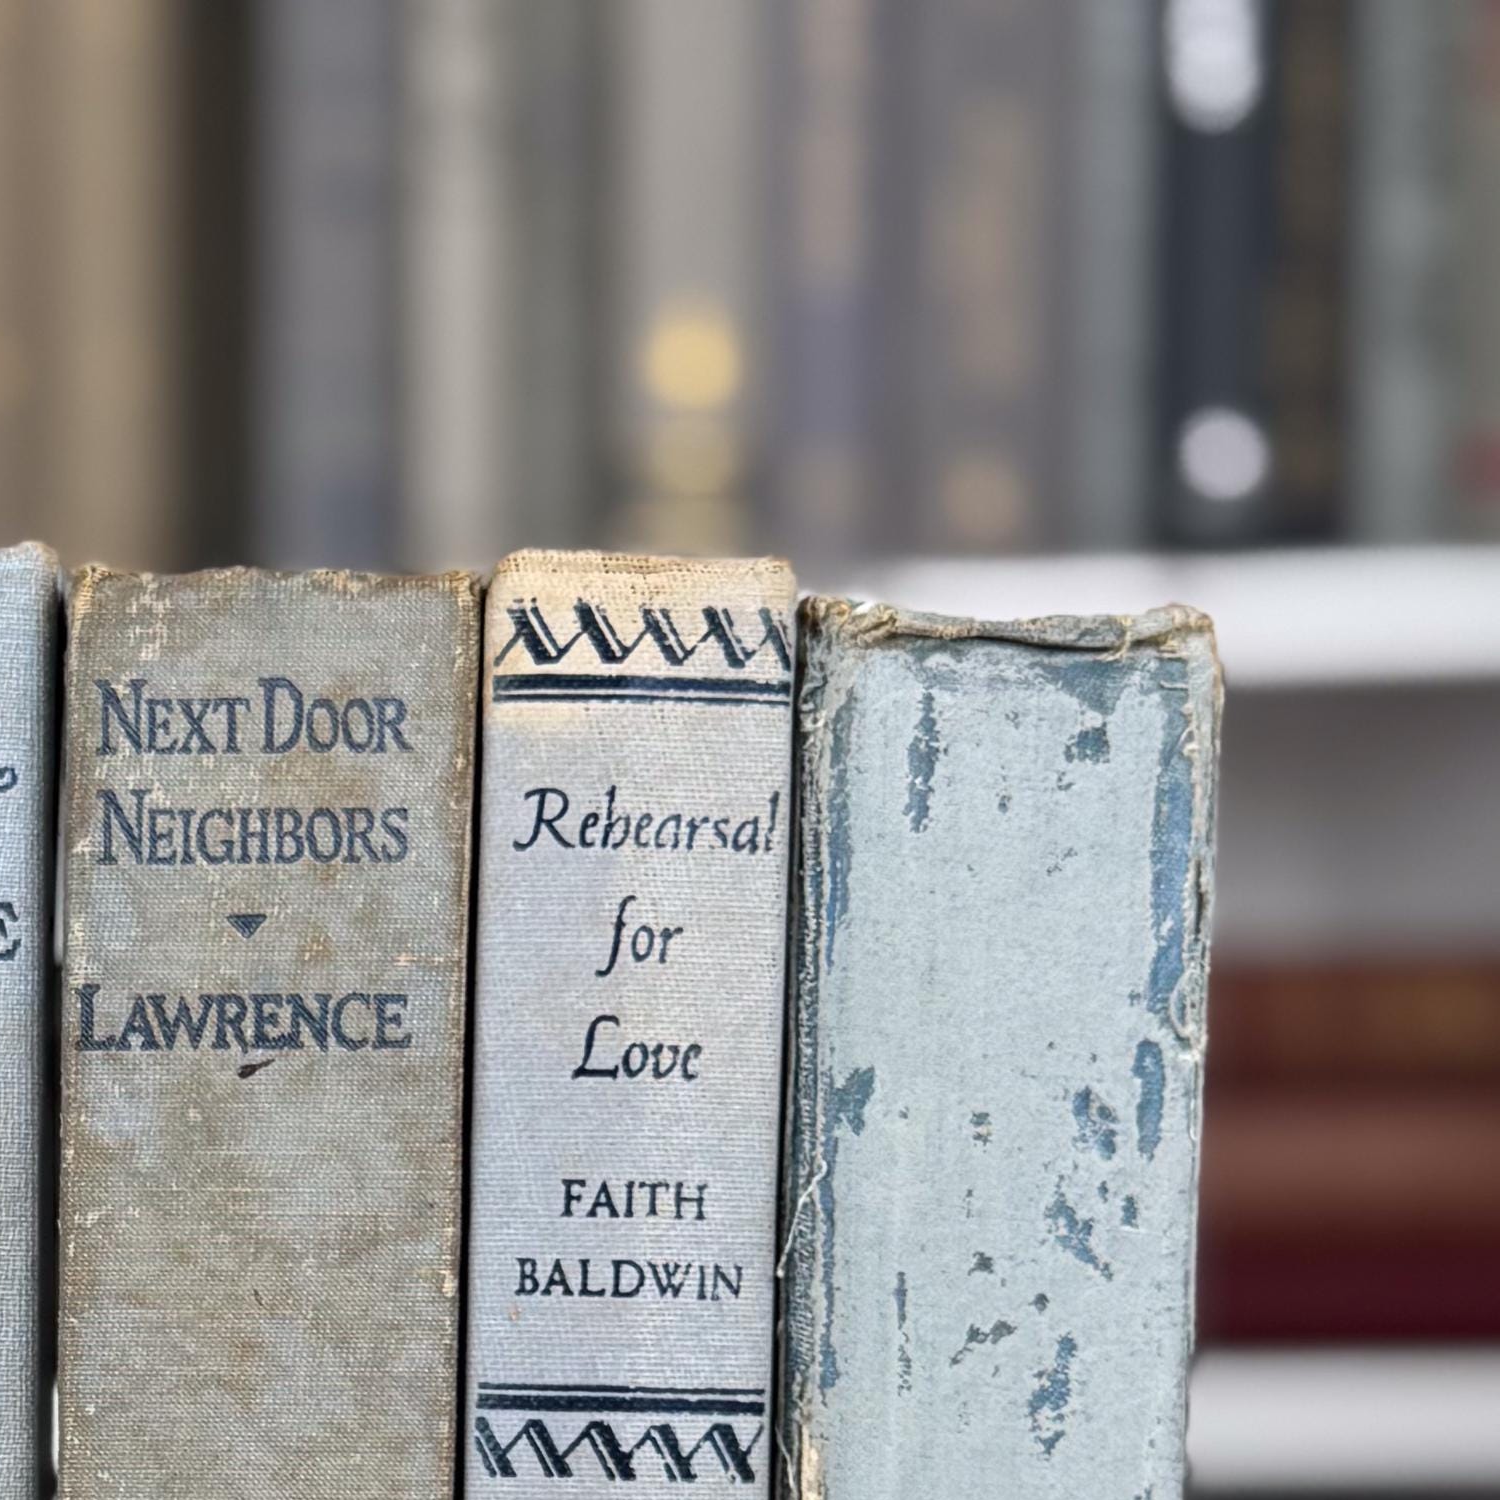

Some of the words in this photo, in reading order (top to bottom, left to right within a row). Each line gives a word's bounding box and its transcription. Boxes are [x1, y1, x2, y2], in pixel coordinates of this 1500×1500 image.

[94, 678, 250, 755] NEXT
[259, 677, 414, 754] DOOR
[97, 788, 409, 866] NEIGHBORS
[512, 786, 781, 854] Rehearsal
[595, 895, 683, 976] for
[75, 983, 411, 1052] LAWRENCE
[572, 1015, 702, 1081] Love
[560, 1179, 708, 1220] FAITH
[515, 1258, 744, 1300] BALDWIN
